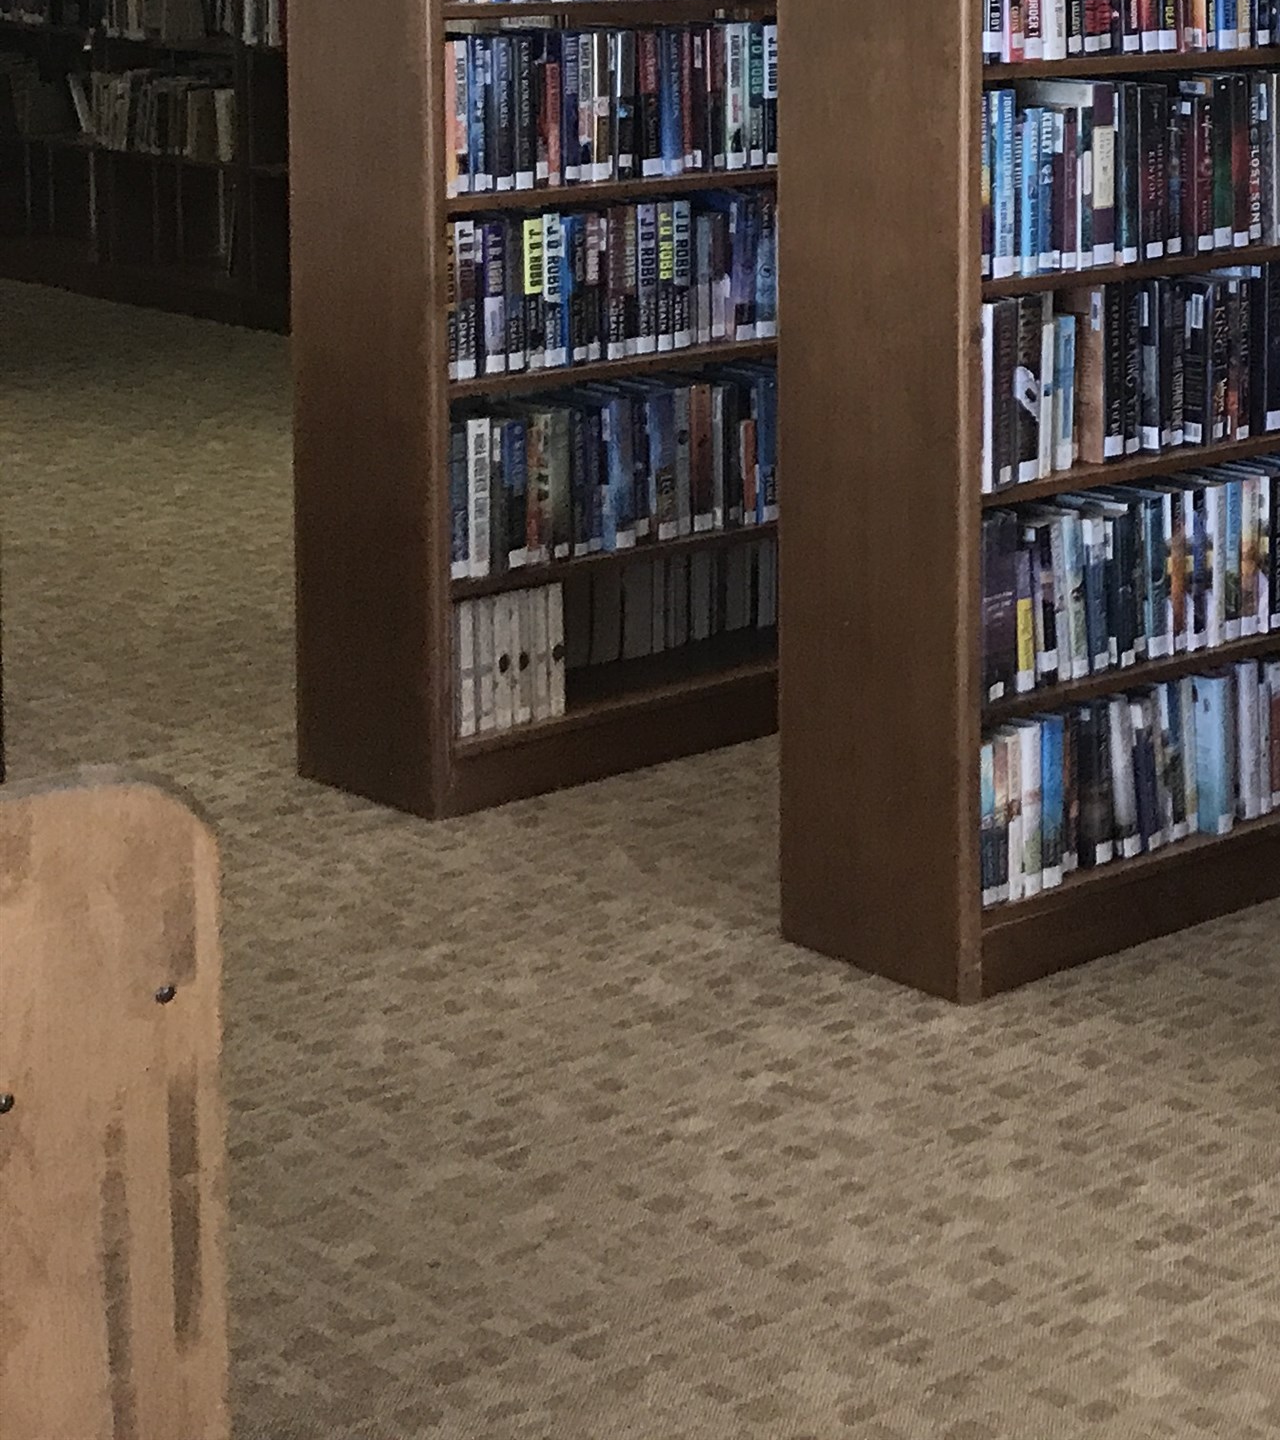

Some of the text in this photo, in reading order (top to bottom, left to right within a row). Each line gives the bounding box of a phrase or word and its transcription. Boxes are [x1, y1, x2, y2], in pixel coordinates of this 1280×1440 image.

[521, 41, 529, 77] KAREN
[731, 35, 740, 88] KAREN ROBARDS
[1003, 97, 1011, 141] JONATHAN
[1042, 113, 1051, 153] KELLEY
[1251, 150, 1260, 222] LOST SON
[548, 256, 560, 295] ROBB
[641, 247, 655, 288] ROBB
[660, 241, 672, 279] ROBB
[676, 239, 687, 277] ROBB
